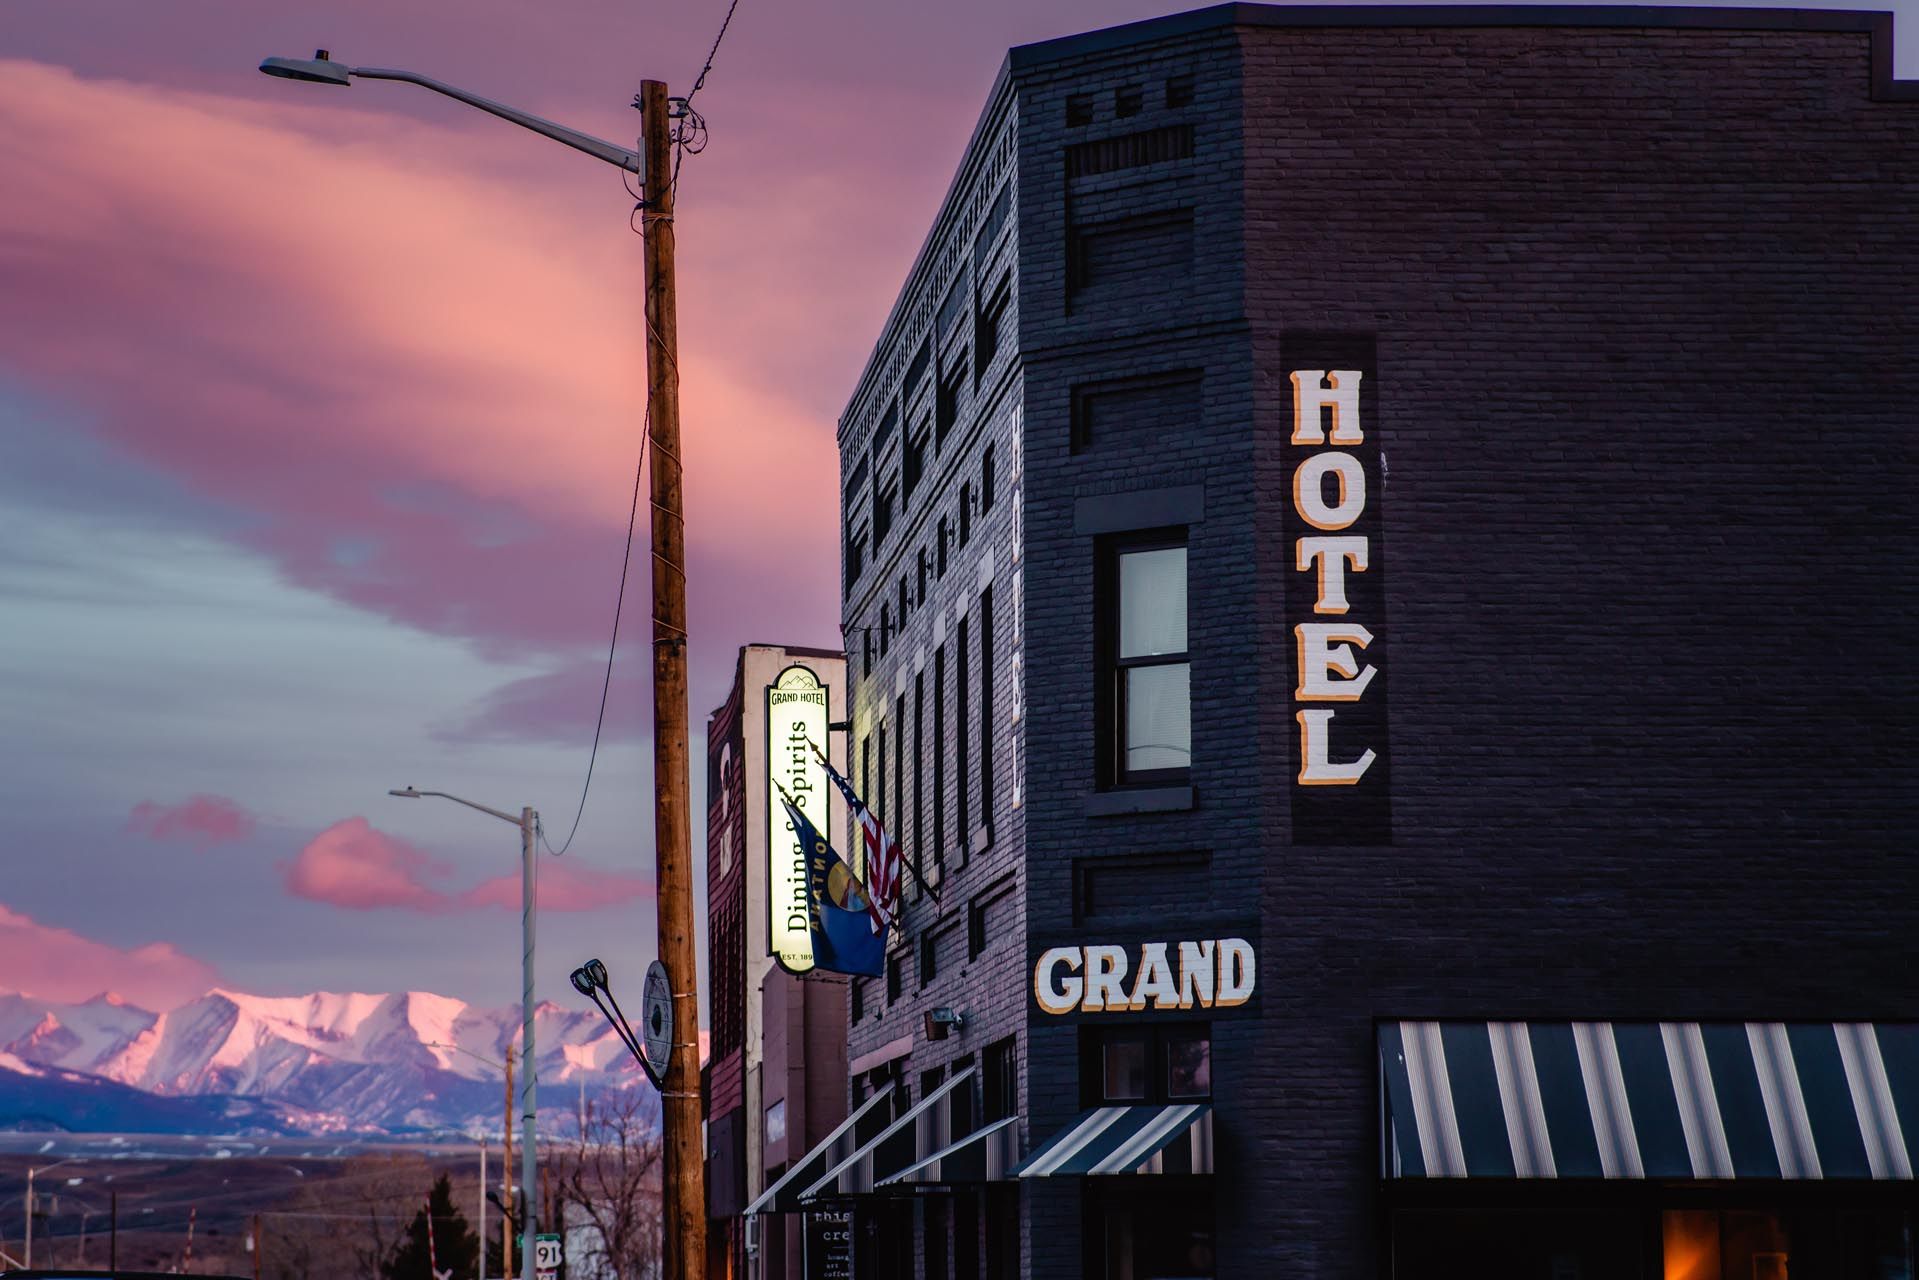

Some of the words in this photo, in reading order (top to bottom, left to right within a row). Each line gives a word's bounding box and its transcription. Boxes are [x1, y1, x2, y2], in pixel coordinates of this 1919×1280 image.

[1290, 369, 1378, 785] HOTEL
[771, 693, 798, 706] GRAND
[800, 693, 825, 706] HOTEL
[786, 720, 813, 808] Spirits
[787, 842, 807, 933] Dining
[782, 953, 797, 961] EST.
[1034, 937, 1256, 1015] GRAND
